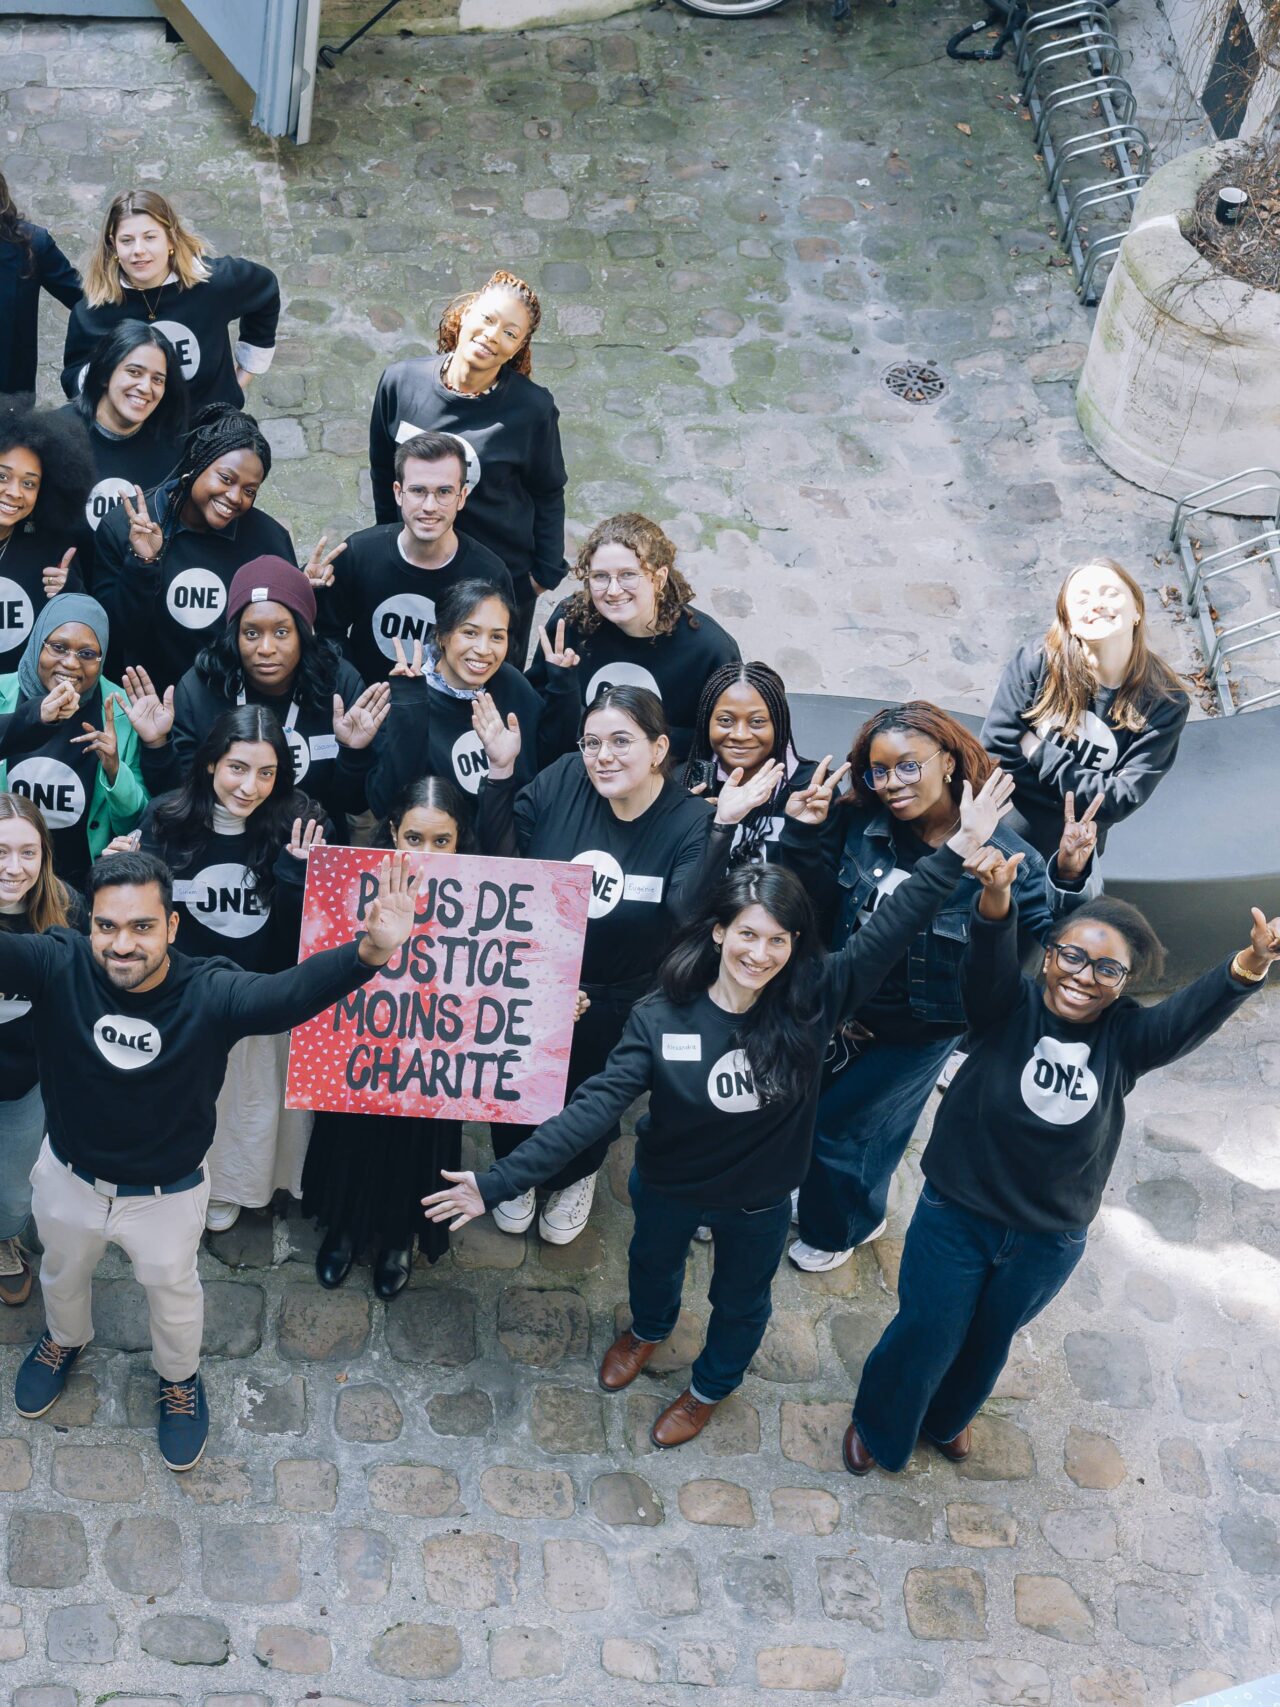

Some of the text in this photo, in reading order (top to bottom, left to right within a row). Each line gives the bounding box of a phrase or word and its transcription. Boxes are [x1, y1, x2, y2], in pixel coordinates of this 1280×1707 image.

[174, 585, 220, 609] ONE
[381, 612, 436, 642] ON
[457, 748, 490, 777] ON
[357, 872, 535, 936] PUS DE
[354, 930, 531, 990] USTICE
[332, 990, 533, 1047] MOINS DE
[101, 1025, 153, 1052] ONE
[345, 1042, 521, 1101] CHARITÉ
[716, 1071, 753, 1098] ON
[1033, 1056, 1089, 1101] ONE
